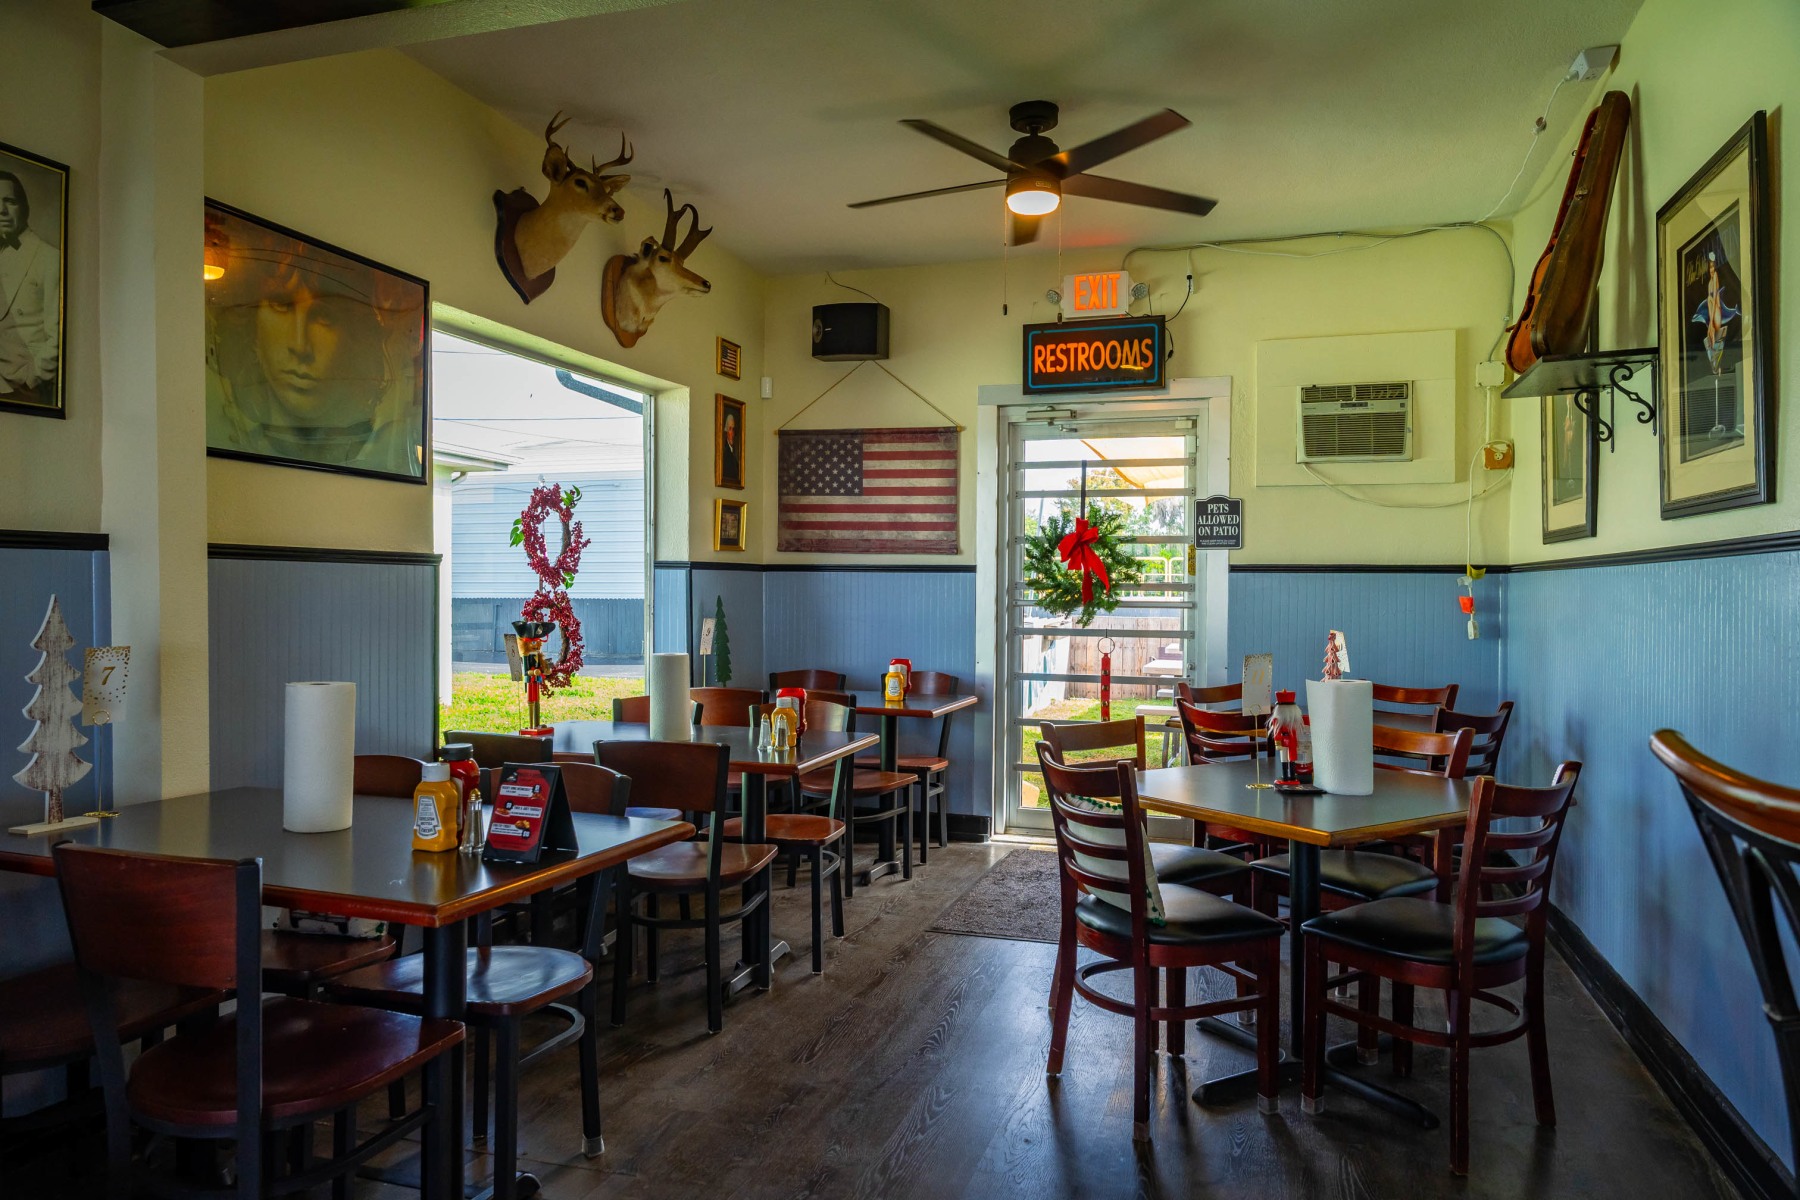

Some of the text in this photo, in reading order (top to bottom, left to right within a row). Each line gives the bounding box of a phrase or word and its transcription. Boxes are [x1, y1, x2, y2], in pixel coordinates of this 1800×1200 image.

[1074, 273, 1121, 310] EXIT
[1034, 338, 1153, 374] RESTROOMS
[1207, 503, 1229, 514] PETS
[1197, 514, 1239, 525] ALLOWED
[1198, 525, 1238, 536] ON PATIO
[101, 665, 116, 686] 7
